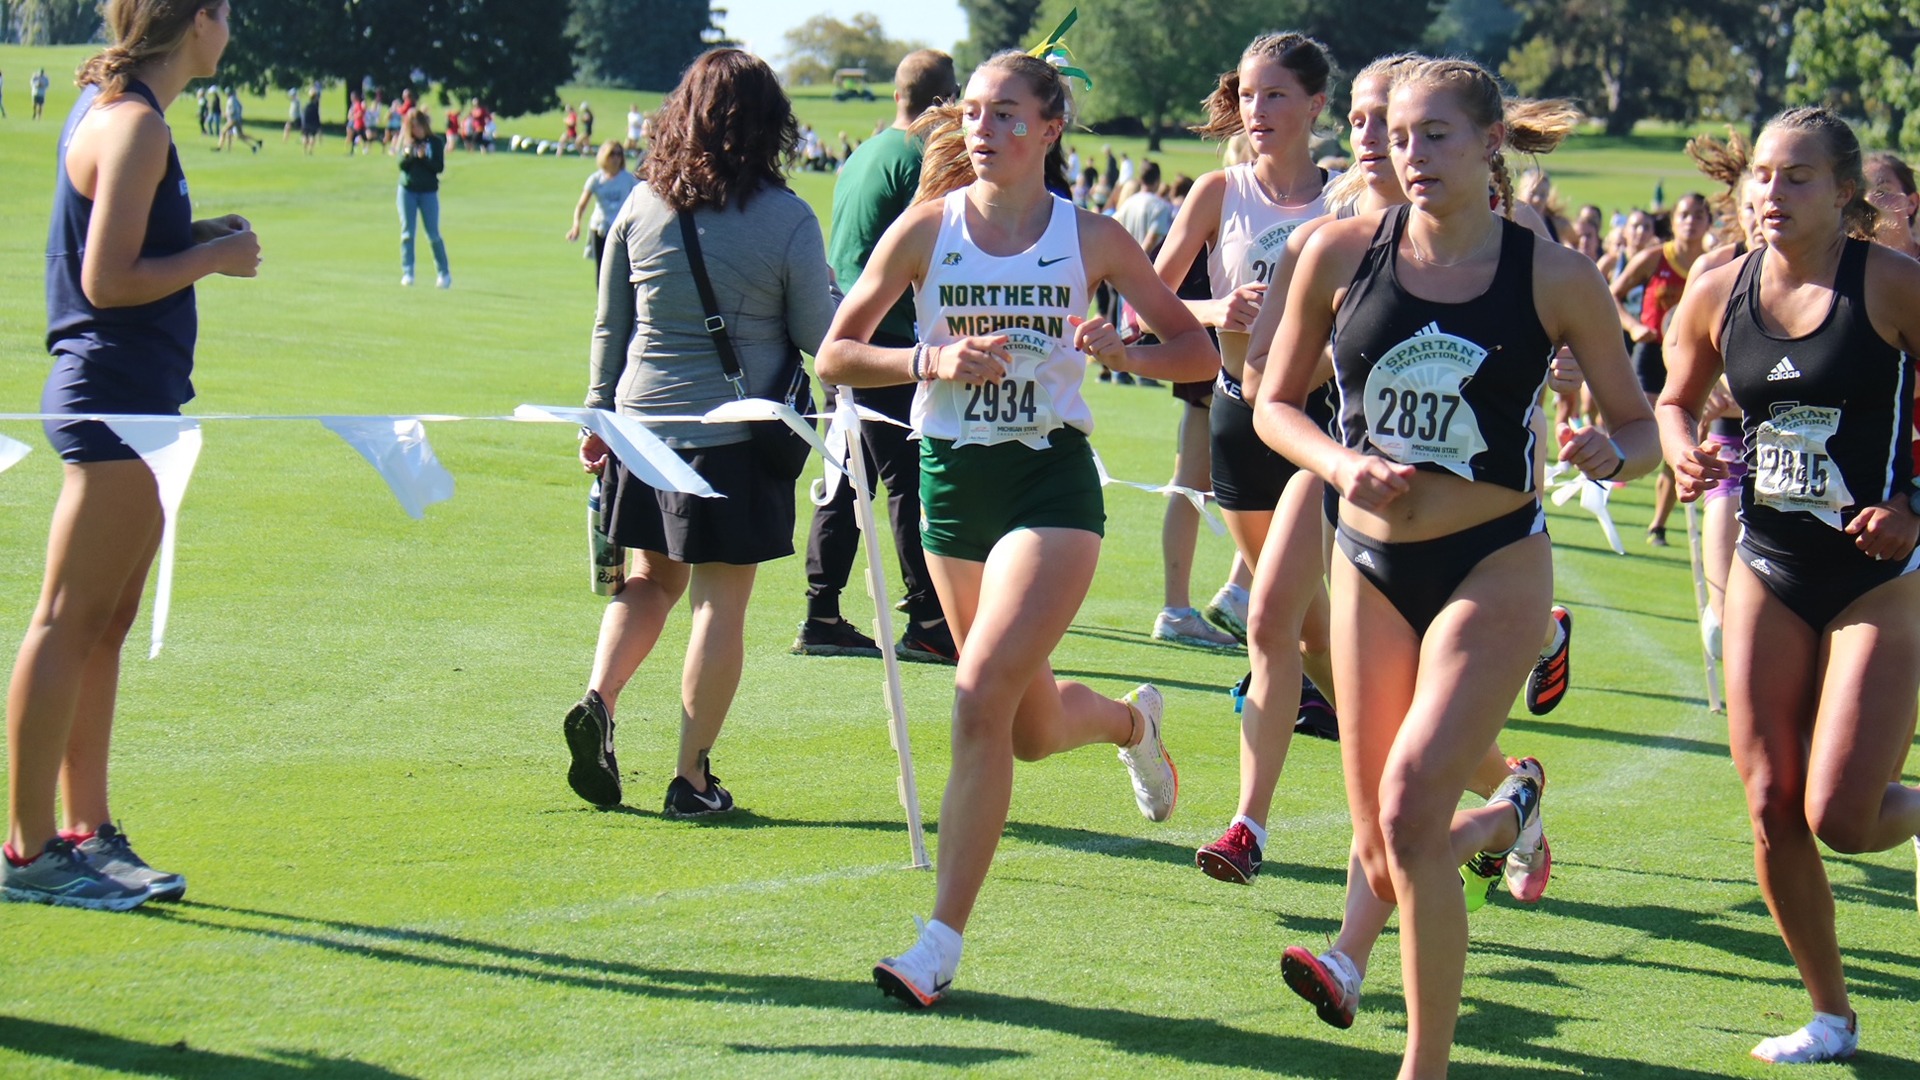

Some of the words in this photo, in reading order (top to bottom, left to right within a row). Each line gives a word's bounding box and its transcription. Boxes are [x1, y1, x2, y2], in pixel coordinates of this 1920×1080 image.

[1259, 224, 1296, 245] SPAR
[938, 285, 1071, 308] NORTHERN
[945, 314, 1063, 338] MICHIGAN
[1002, 343, 1045, 355] ATIONAL
[1385, 340, 1476, 368] SPARTAN
[1391, 351, 1473, 375] INVITATIONAL
[1766, 369, 1800, 381] adidas
[964, 379, 1037, 423] 2934
[1375, 387, 1461, 442] 2837
[1772, 409, 1832, 429] PARTAN
[1411, 444, 1440, 453] MICHIGAN
